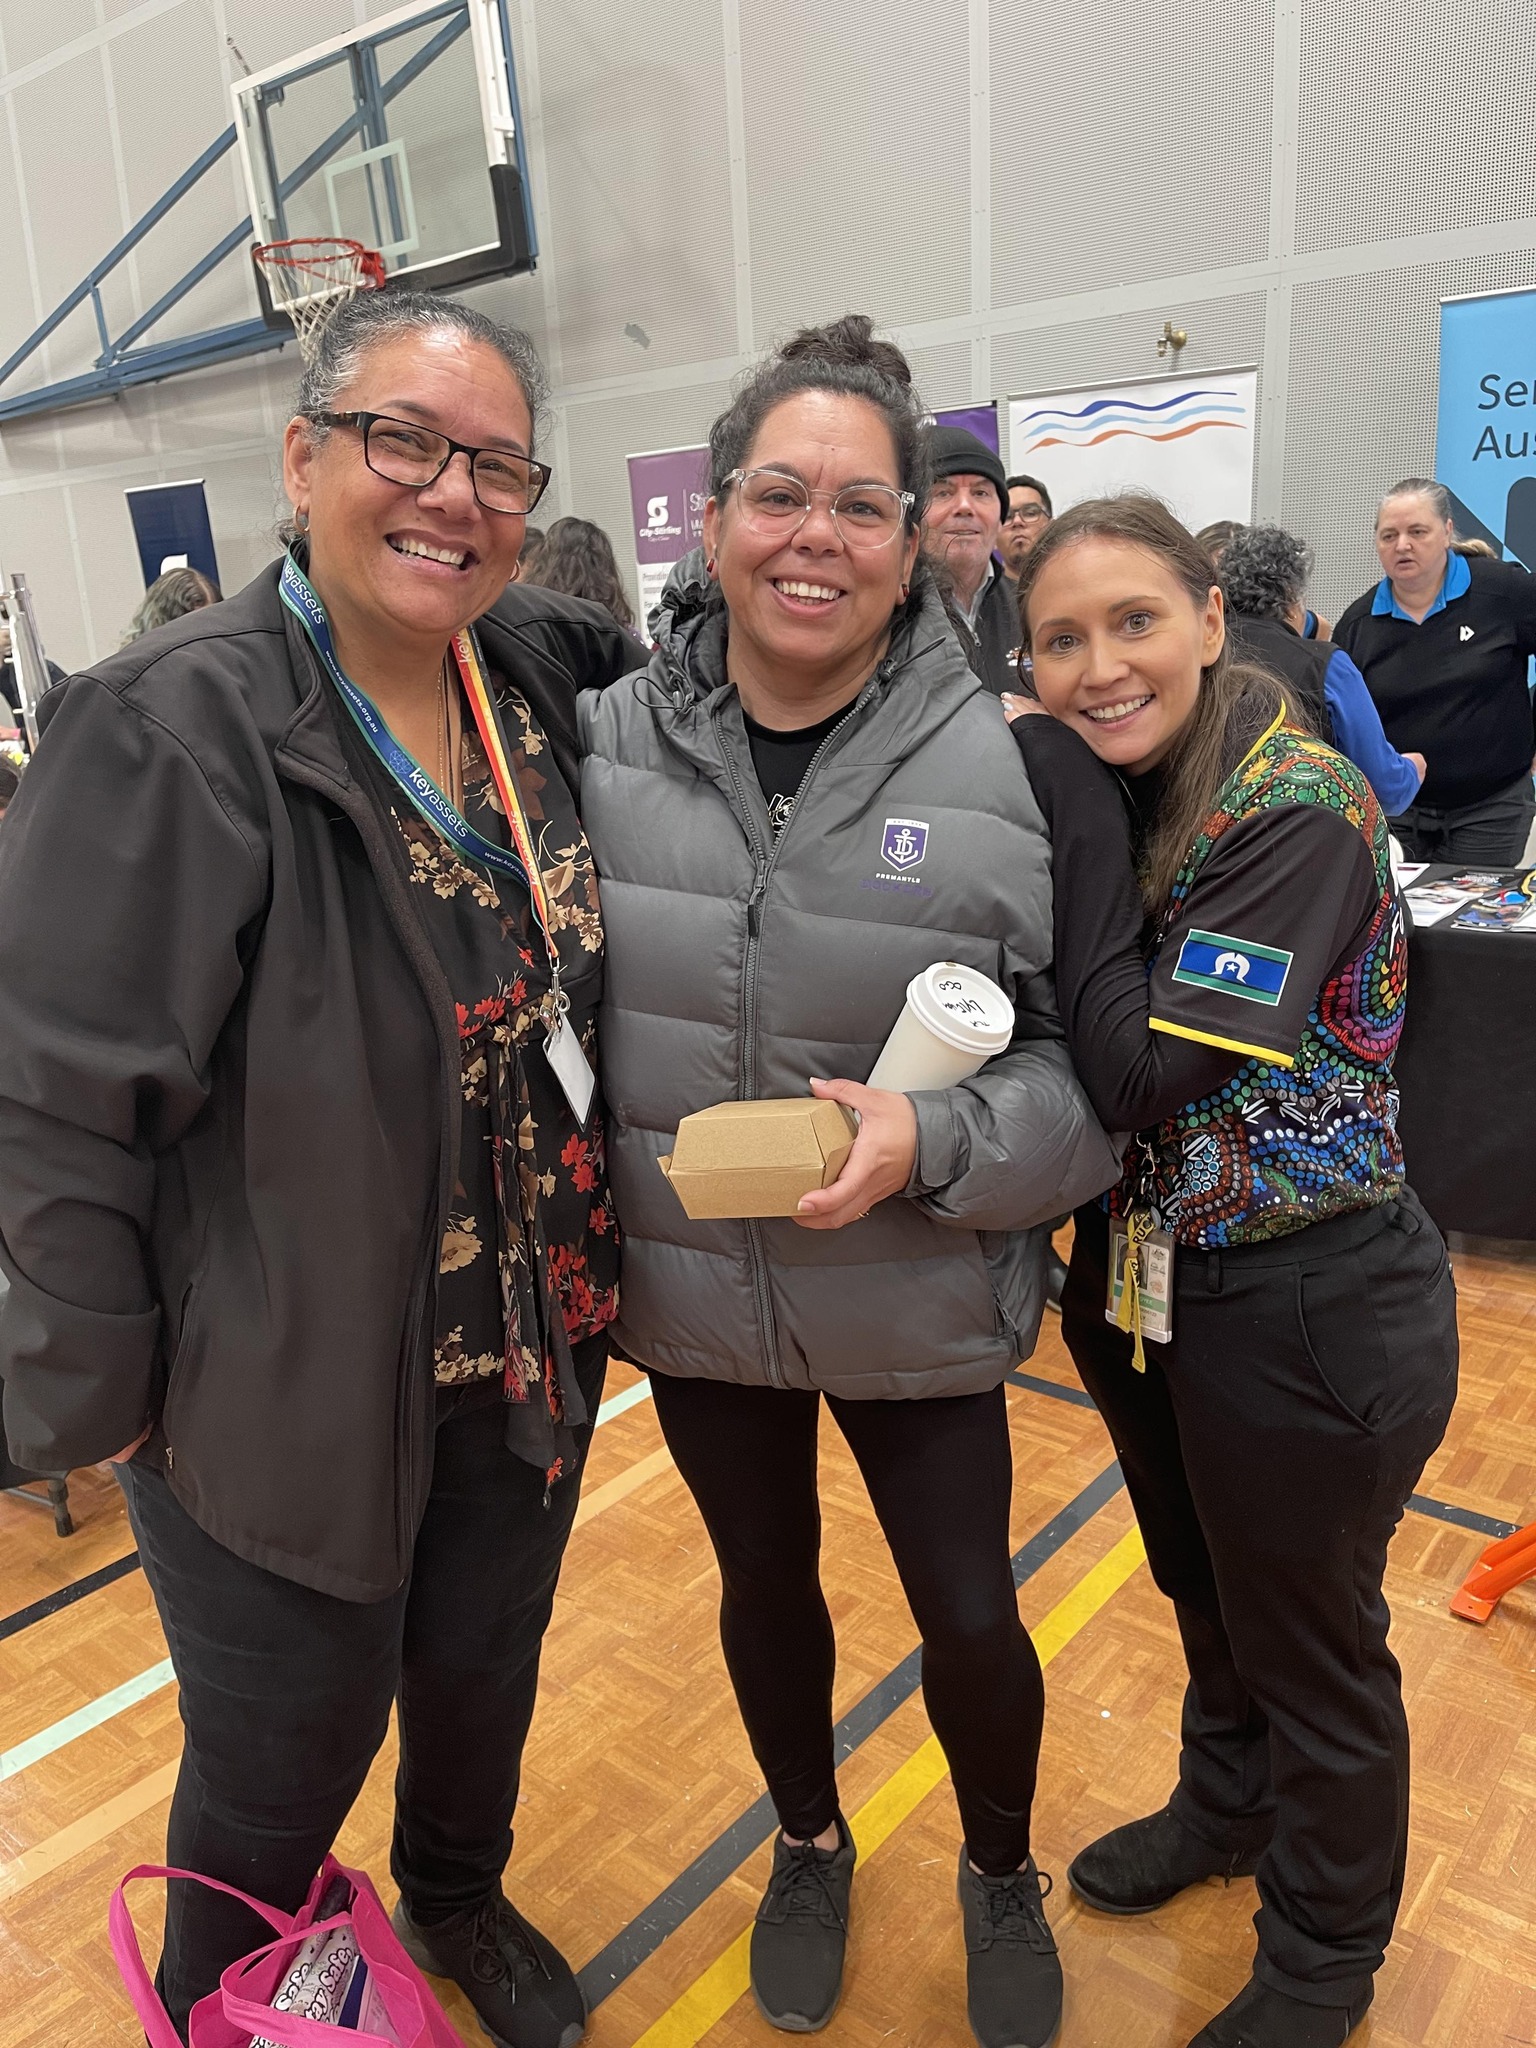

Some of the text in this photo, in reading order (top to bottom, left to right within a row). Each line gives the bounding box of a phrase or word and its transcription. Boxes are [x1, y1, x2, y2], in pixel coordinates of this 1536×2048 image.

[284, 559, 324, 624] keyassets
[325, 651, 378, 733] www.keyassets.org.au
[409, 767, 468, 838] keyassets
[303, 1987, 328, 2023] tay
